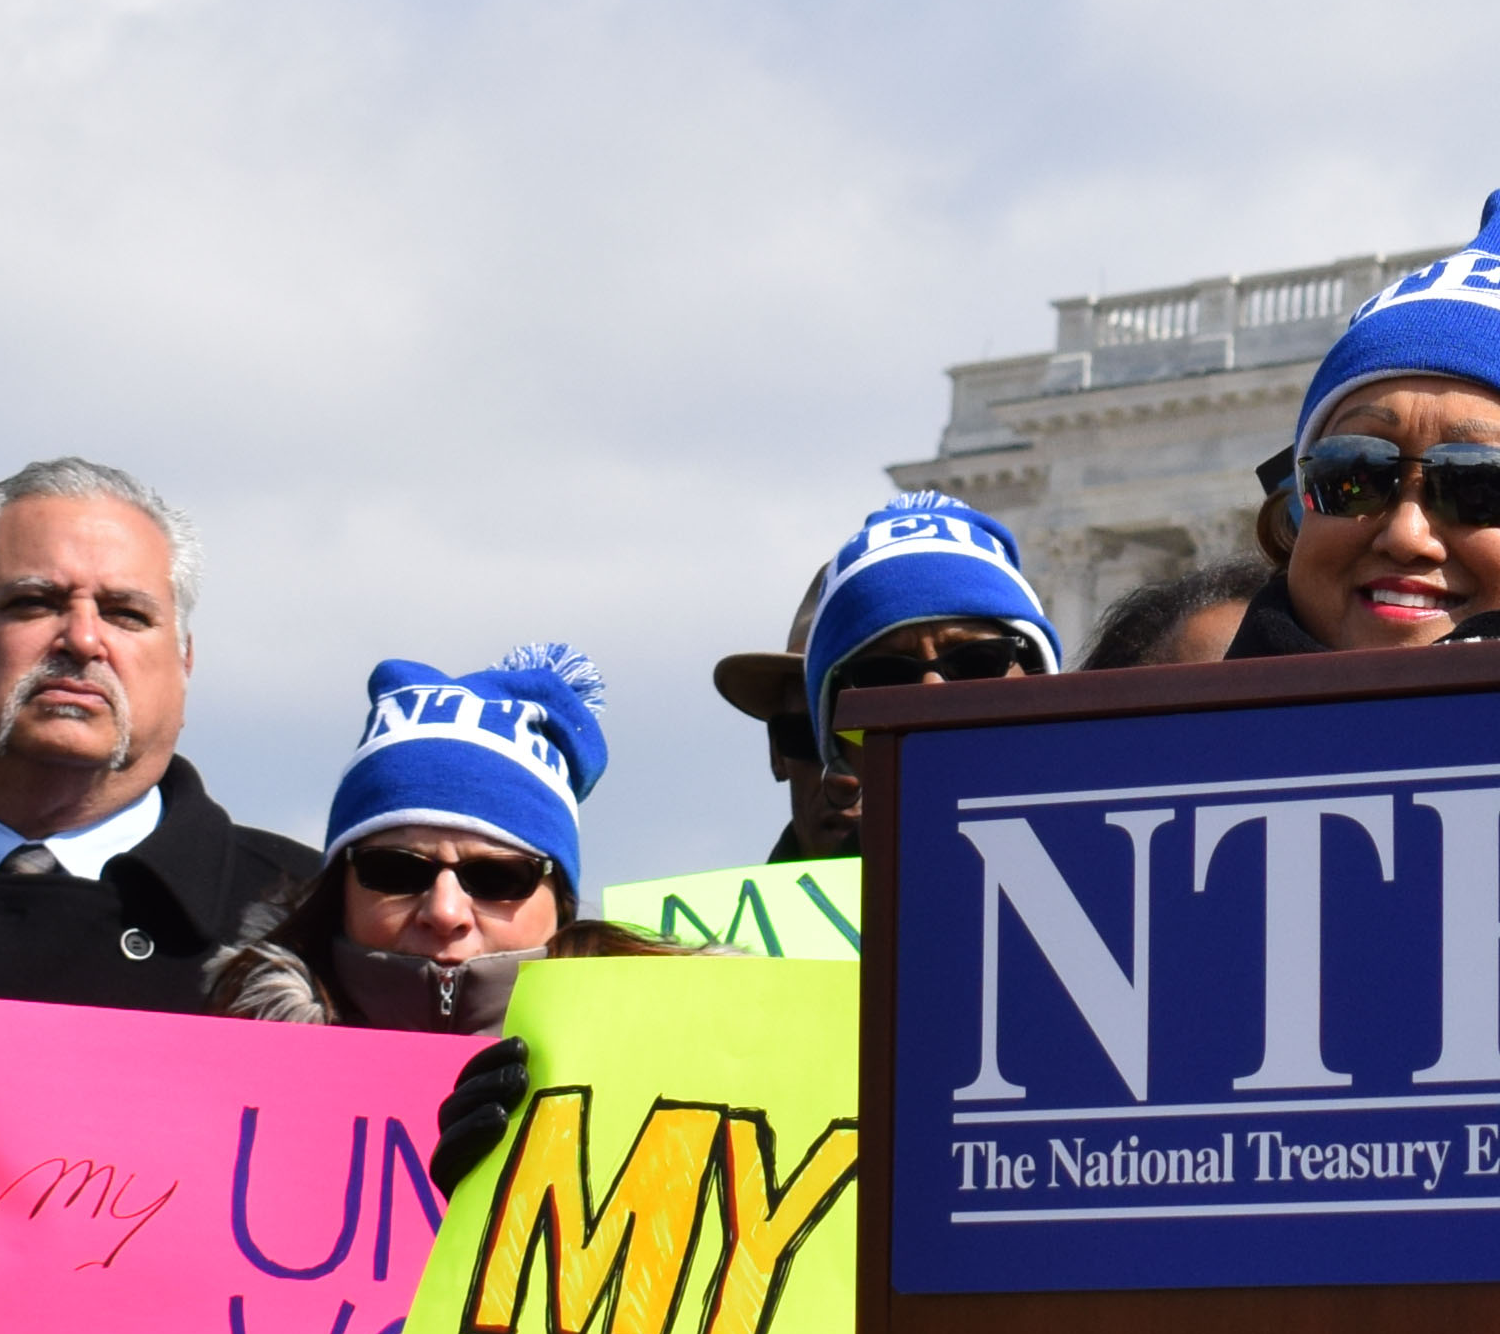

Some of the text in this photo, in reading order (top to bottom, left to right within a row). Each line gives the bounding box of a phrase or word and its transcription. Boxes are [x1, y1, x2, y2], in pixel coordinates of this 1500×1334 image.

[951, 1141, 1036, 1191] The
[1047, 1133, 1236, 1189] National
[1247, 1130, 1452, 1192] Treasury
